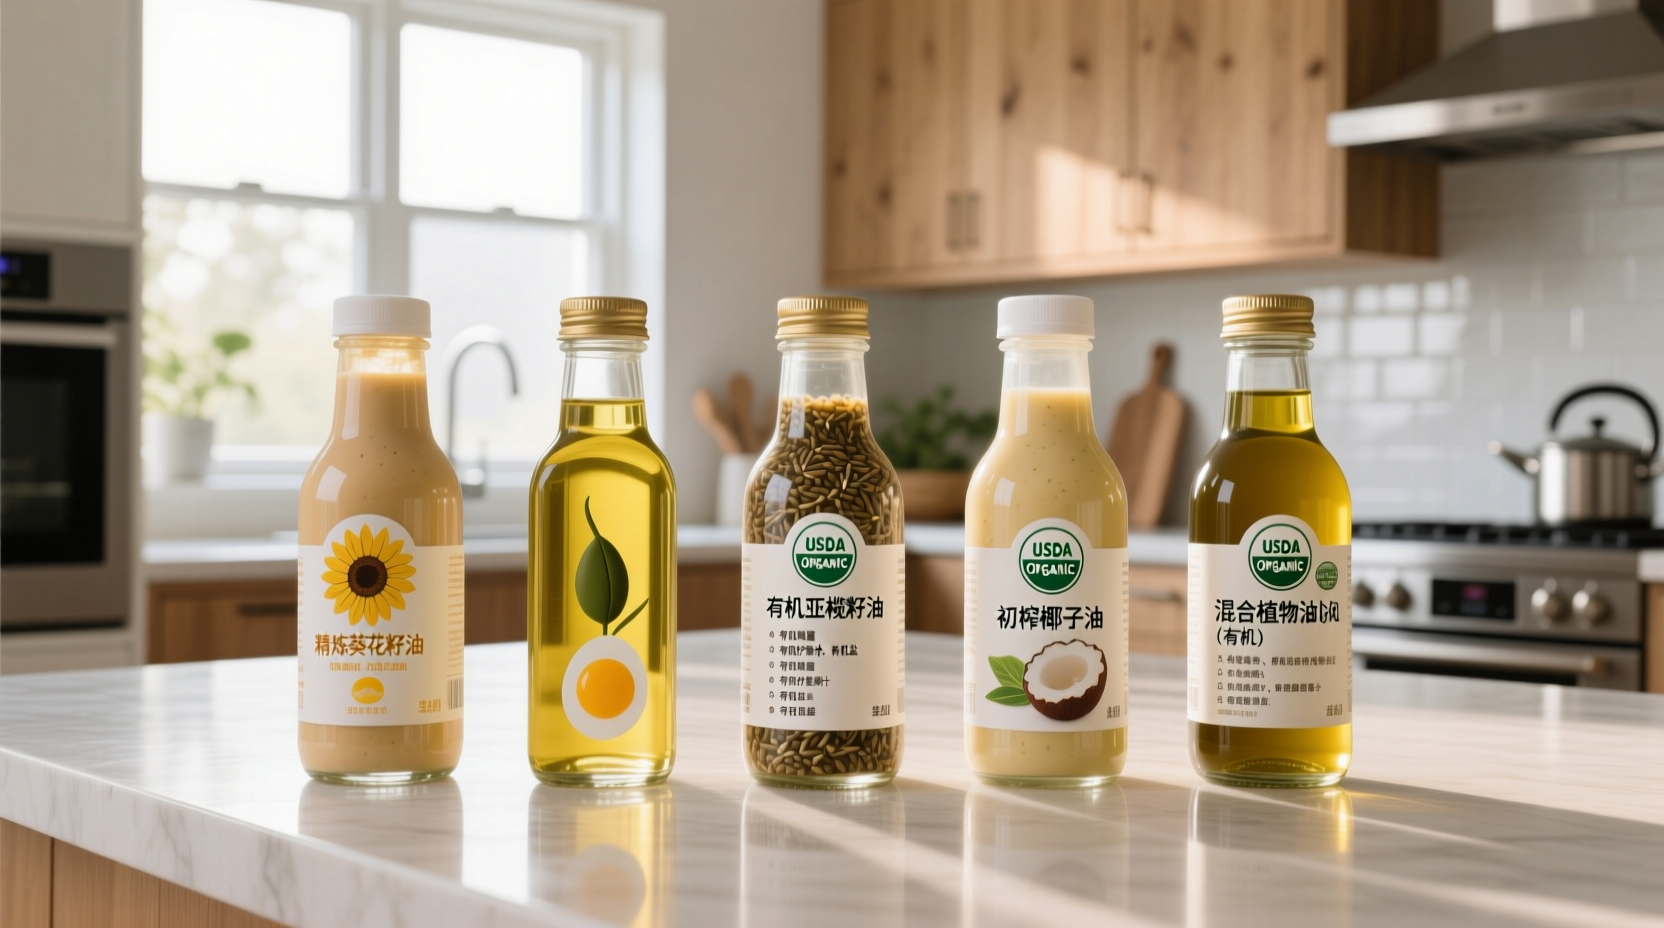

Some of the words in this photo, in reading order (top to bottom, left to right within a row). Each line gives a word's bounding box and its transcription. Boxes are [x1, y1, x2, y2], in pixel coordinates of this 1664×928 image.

[805, 537, 846, 552] USDA
[1032, 542, 1073, 557] USDA
[1262, 539, 1301, 554] USDA
[996, 605, 1104, 631] 初榨椰子油
[314, 632, 424, 657] 精炼葵花籽油
